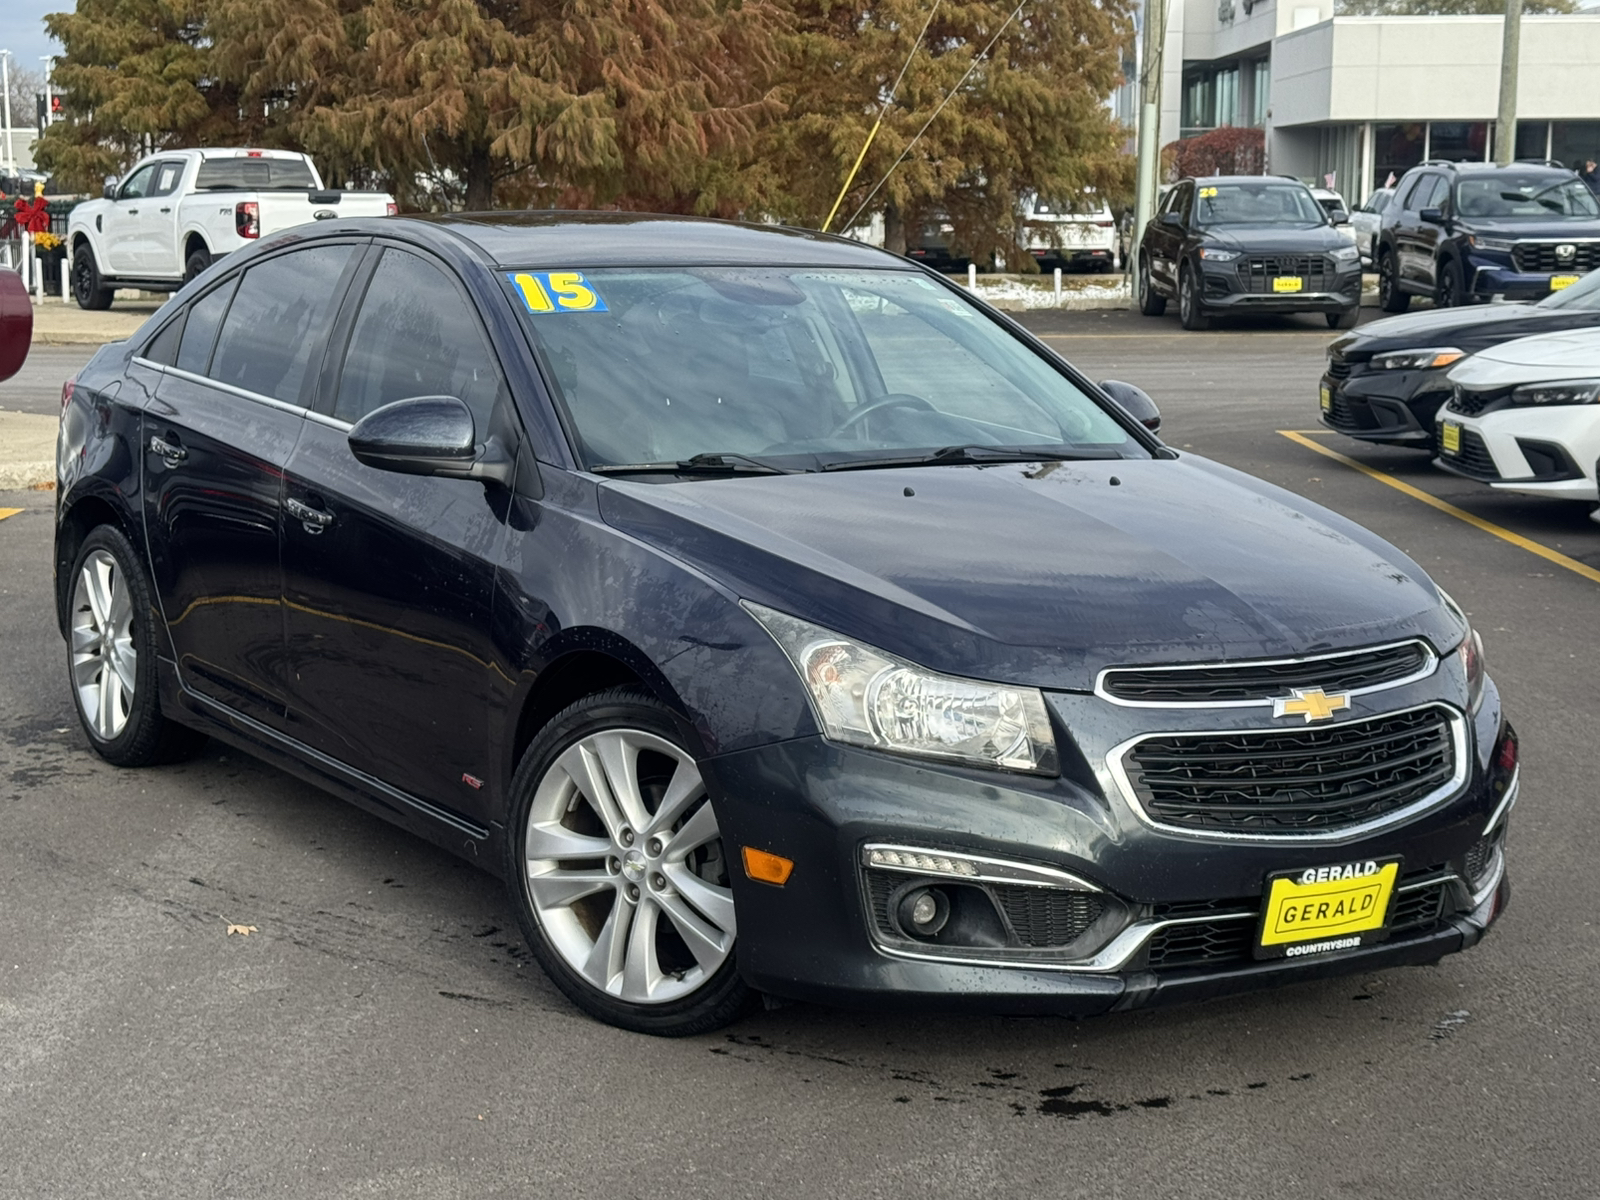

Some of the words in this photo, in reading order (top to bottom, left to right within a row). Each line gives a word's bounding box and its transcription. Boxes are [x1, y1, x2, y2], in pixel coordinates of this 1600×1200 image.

[514, 273, 597, 312] 15
[1302, 861, 1377, 885] GERALD
[1284, 894, 1373, 923] GERALD
[1286, 936, 1361, 956] COUNTRYSIDE
